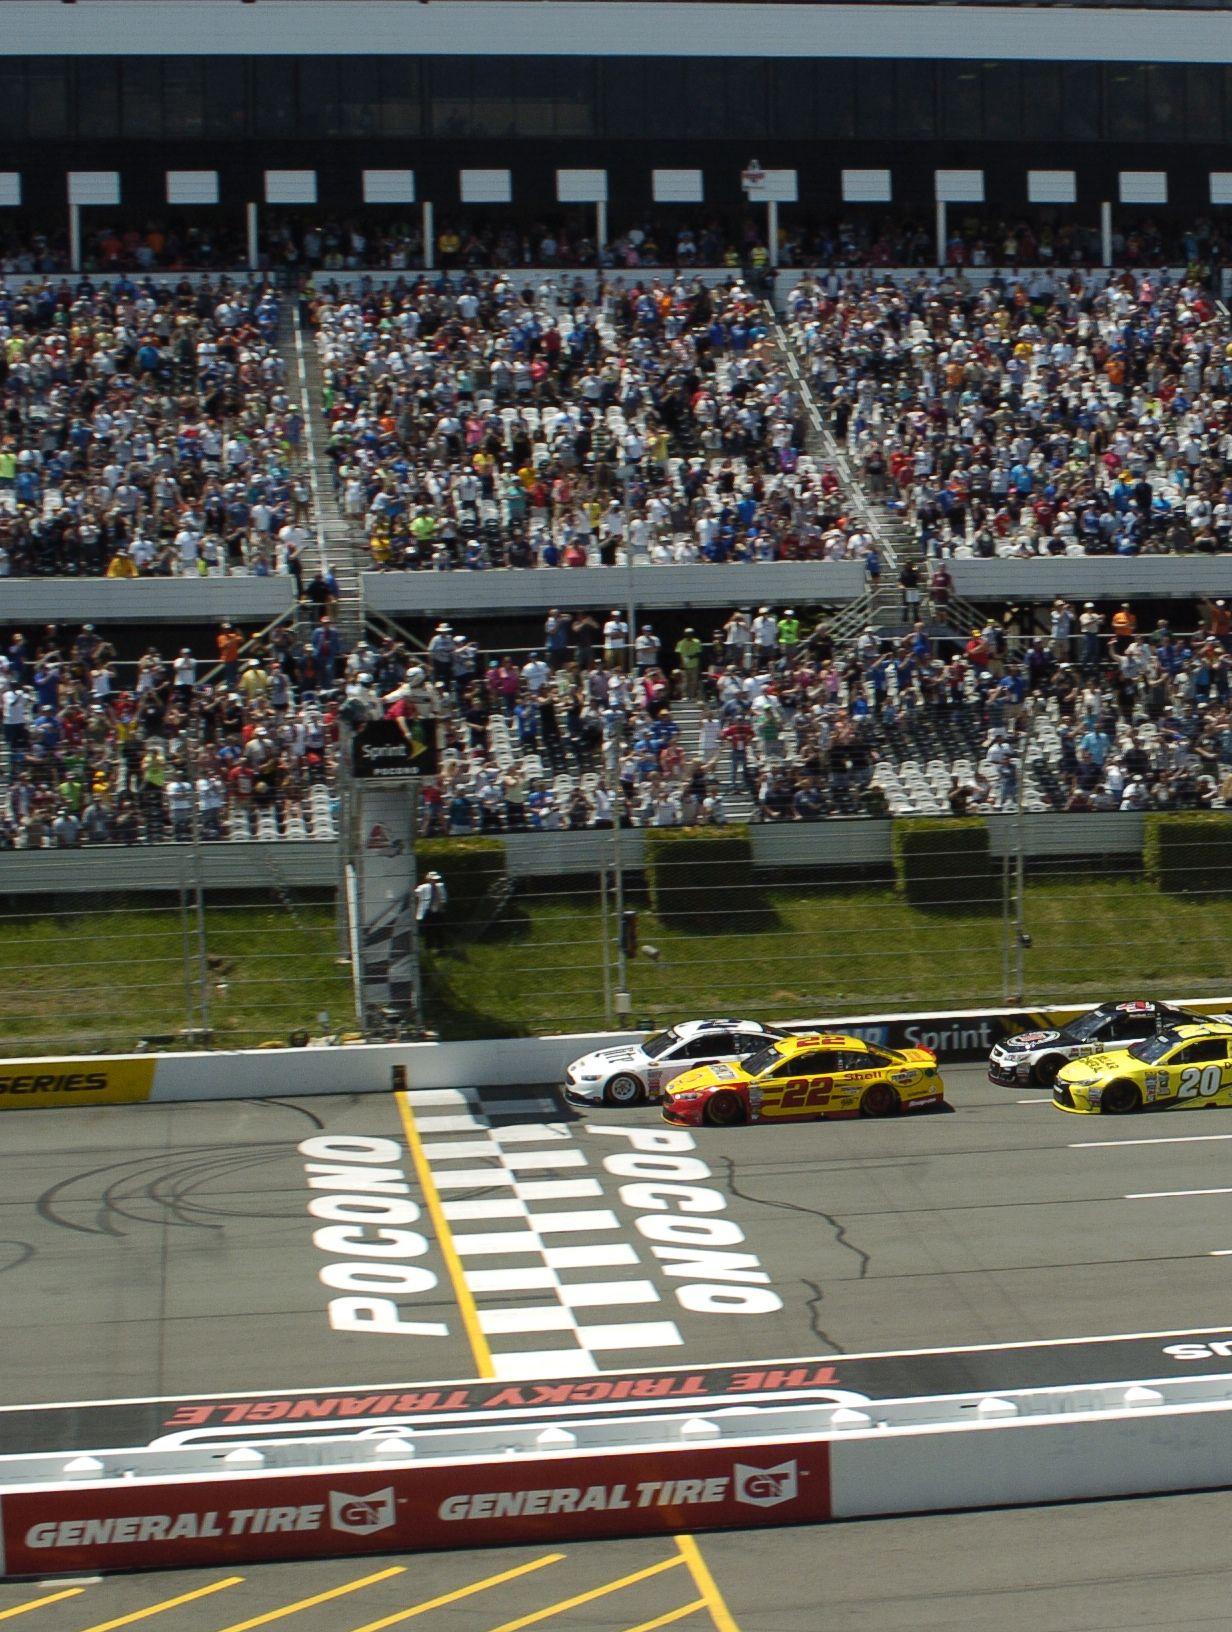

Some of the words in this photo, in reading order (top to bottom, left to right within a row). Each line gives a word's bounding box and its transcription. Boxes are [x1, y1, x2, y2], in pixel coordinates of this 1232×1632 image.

[361, 743, 408, 760] Sprint
[796, 1035, 846, 1047] 22
[904, 1021, 993, 1050] Sprint
[780, 1076, 834, 1109] 22
[843, 1071, 883, 1081] Shell
[1176, 1065, 1222, 1099] 20
[297, 1134, 450, 1337] POCONO
[586, 1124, 784, 1315] POCONO
[484, 1375, 709, 1408] TRICKY
[726, 1366, 841, 1393] THE
[163, 1390, 470, 1427] TRIANGLE
[437, 1485, 637, 1522] GENERAL
[636, 1476, 731, 1508] TIRE
[24, 1509, 224, 1549] GENERAL
[227, 1503, 326, 1536] TIRE
